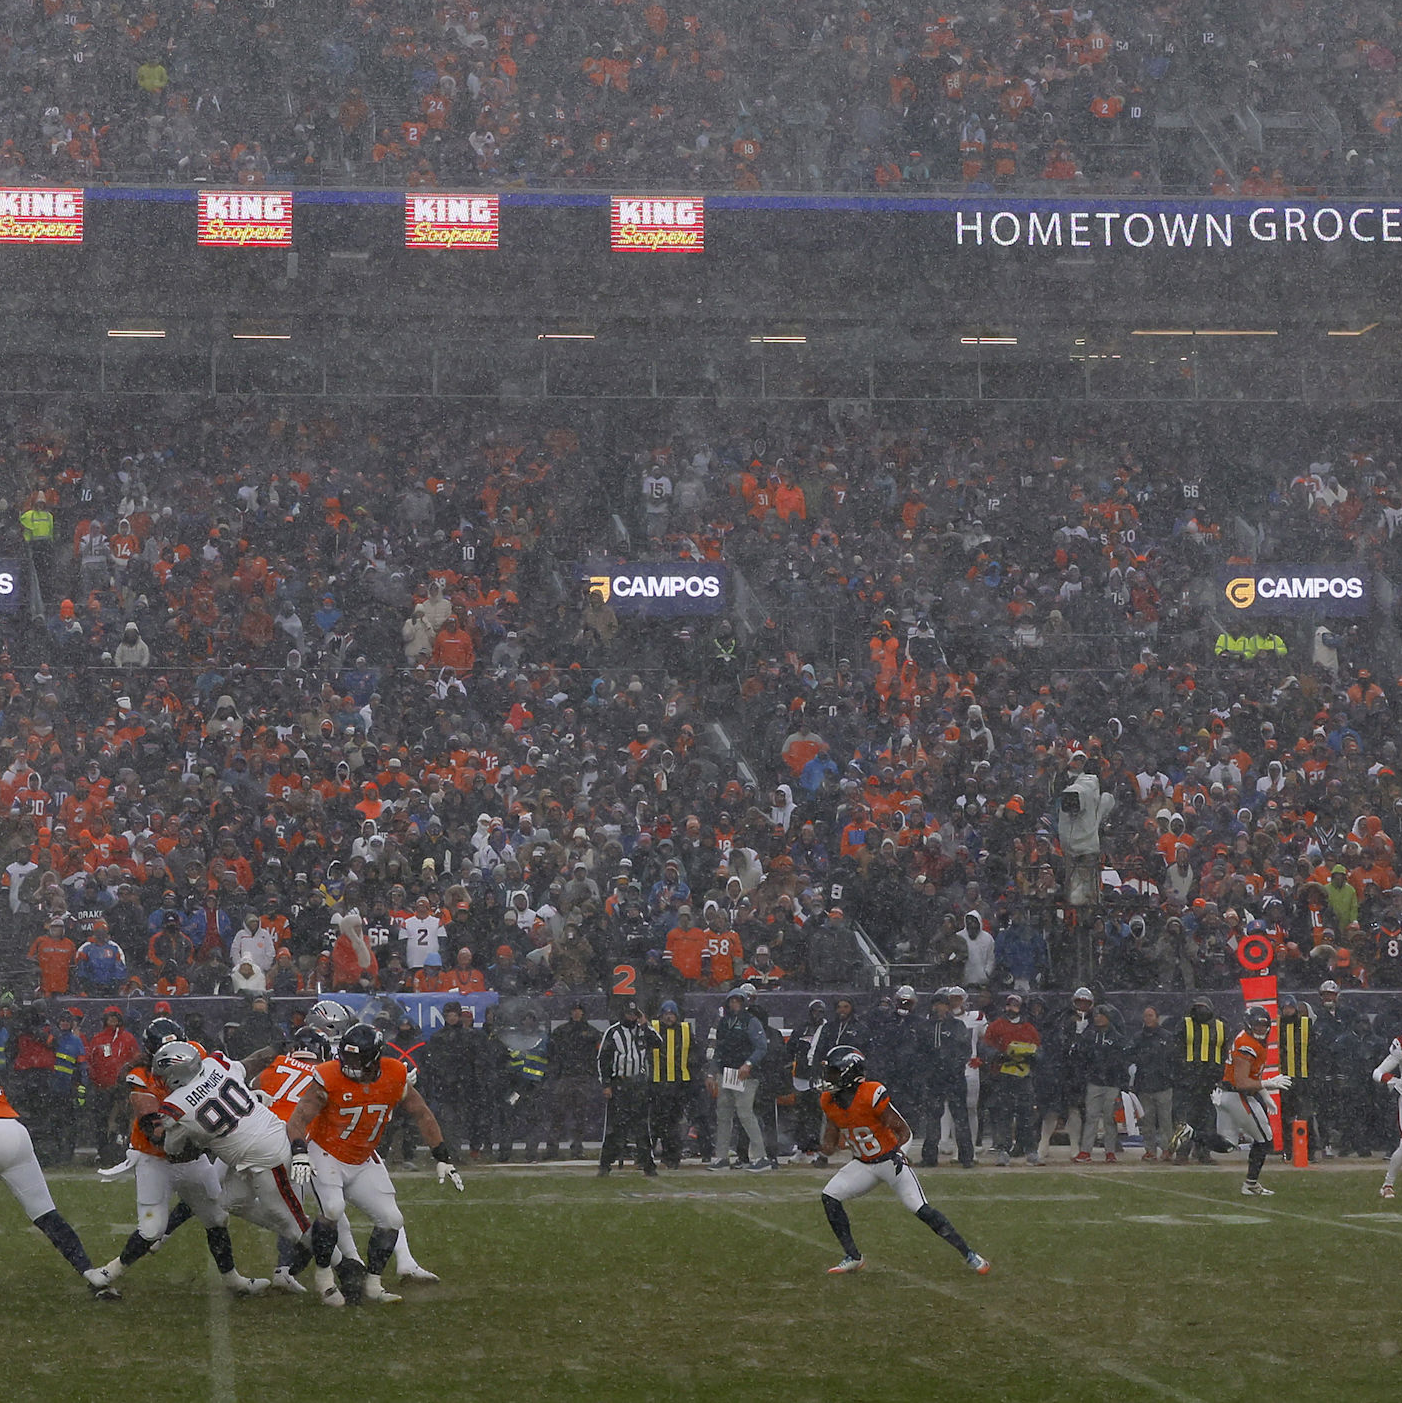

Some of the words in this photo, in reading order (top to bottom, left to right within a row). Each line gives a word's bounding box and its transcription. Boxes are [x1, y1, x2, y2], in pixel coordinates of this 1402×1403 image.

[1130, 107, 1141, 118] 10
[206, 194, 284, 220] KING
[413, 196, 491, 222] KING
[619, 199, 696, 225] KING
[956, 211, 1233, 248] HOMETOWN
[650, 483, 663, 498] 15
[462, 546, 475, 560] 10
[612, 576, 720, 597] CAMPOS
[1257, 577, 1363, 598] CAMPOS
[368, 928, 390, 947] 66
[417, 928, 428, 946] 2
[708, 939, 730, 956] 58
[1387, 940, 1399, 958] 8
[613, 964, 636, 995] 2
[185, 1069, 224, 1107] BARMORE
[195, 1077, 255, 1138] 90
[339, 1104, 389, 1142] 77
